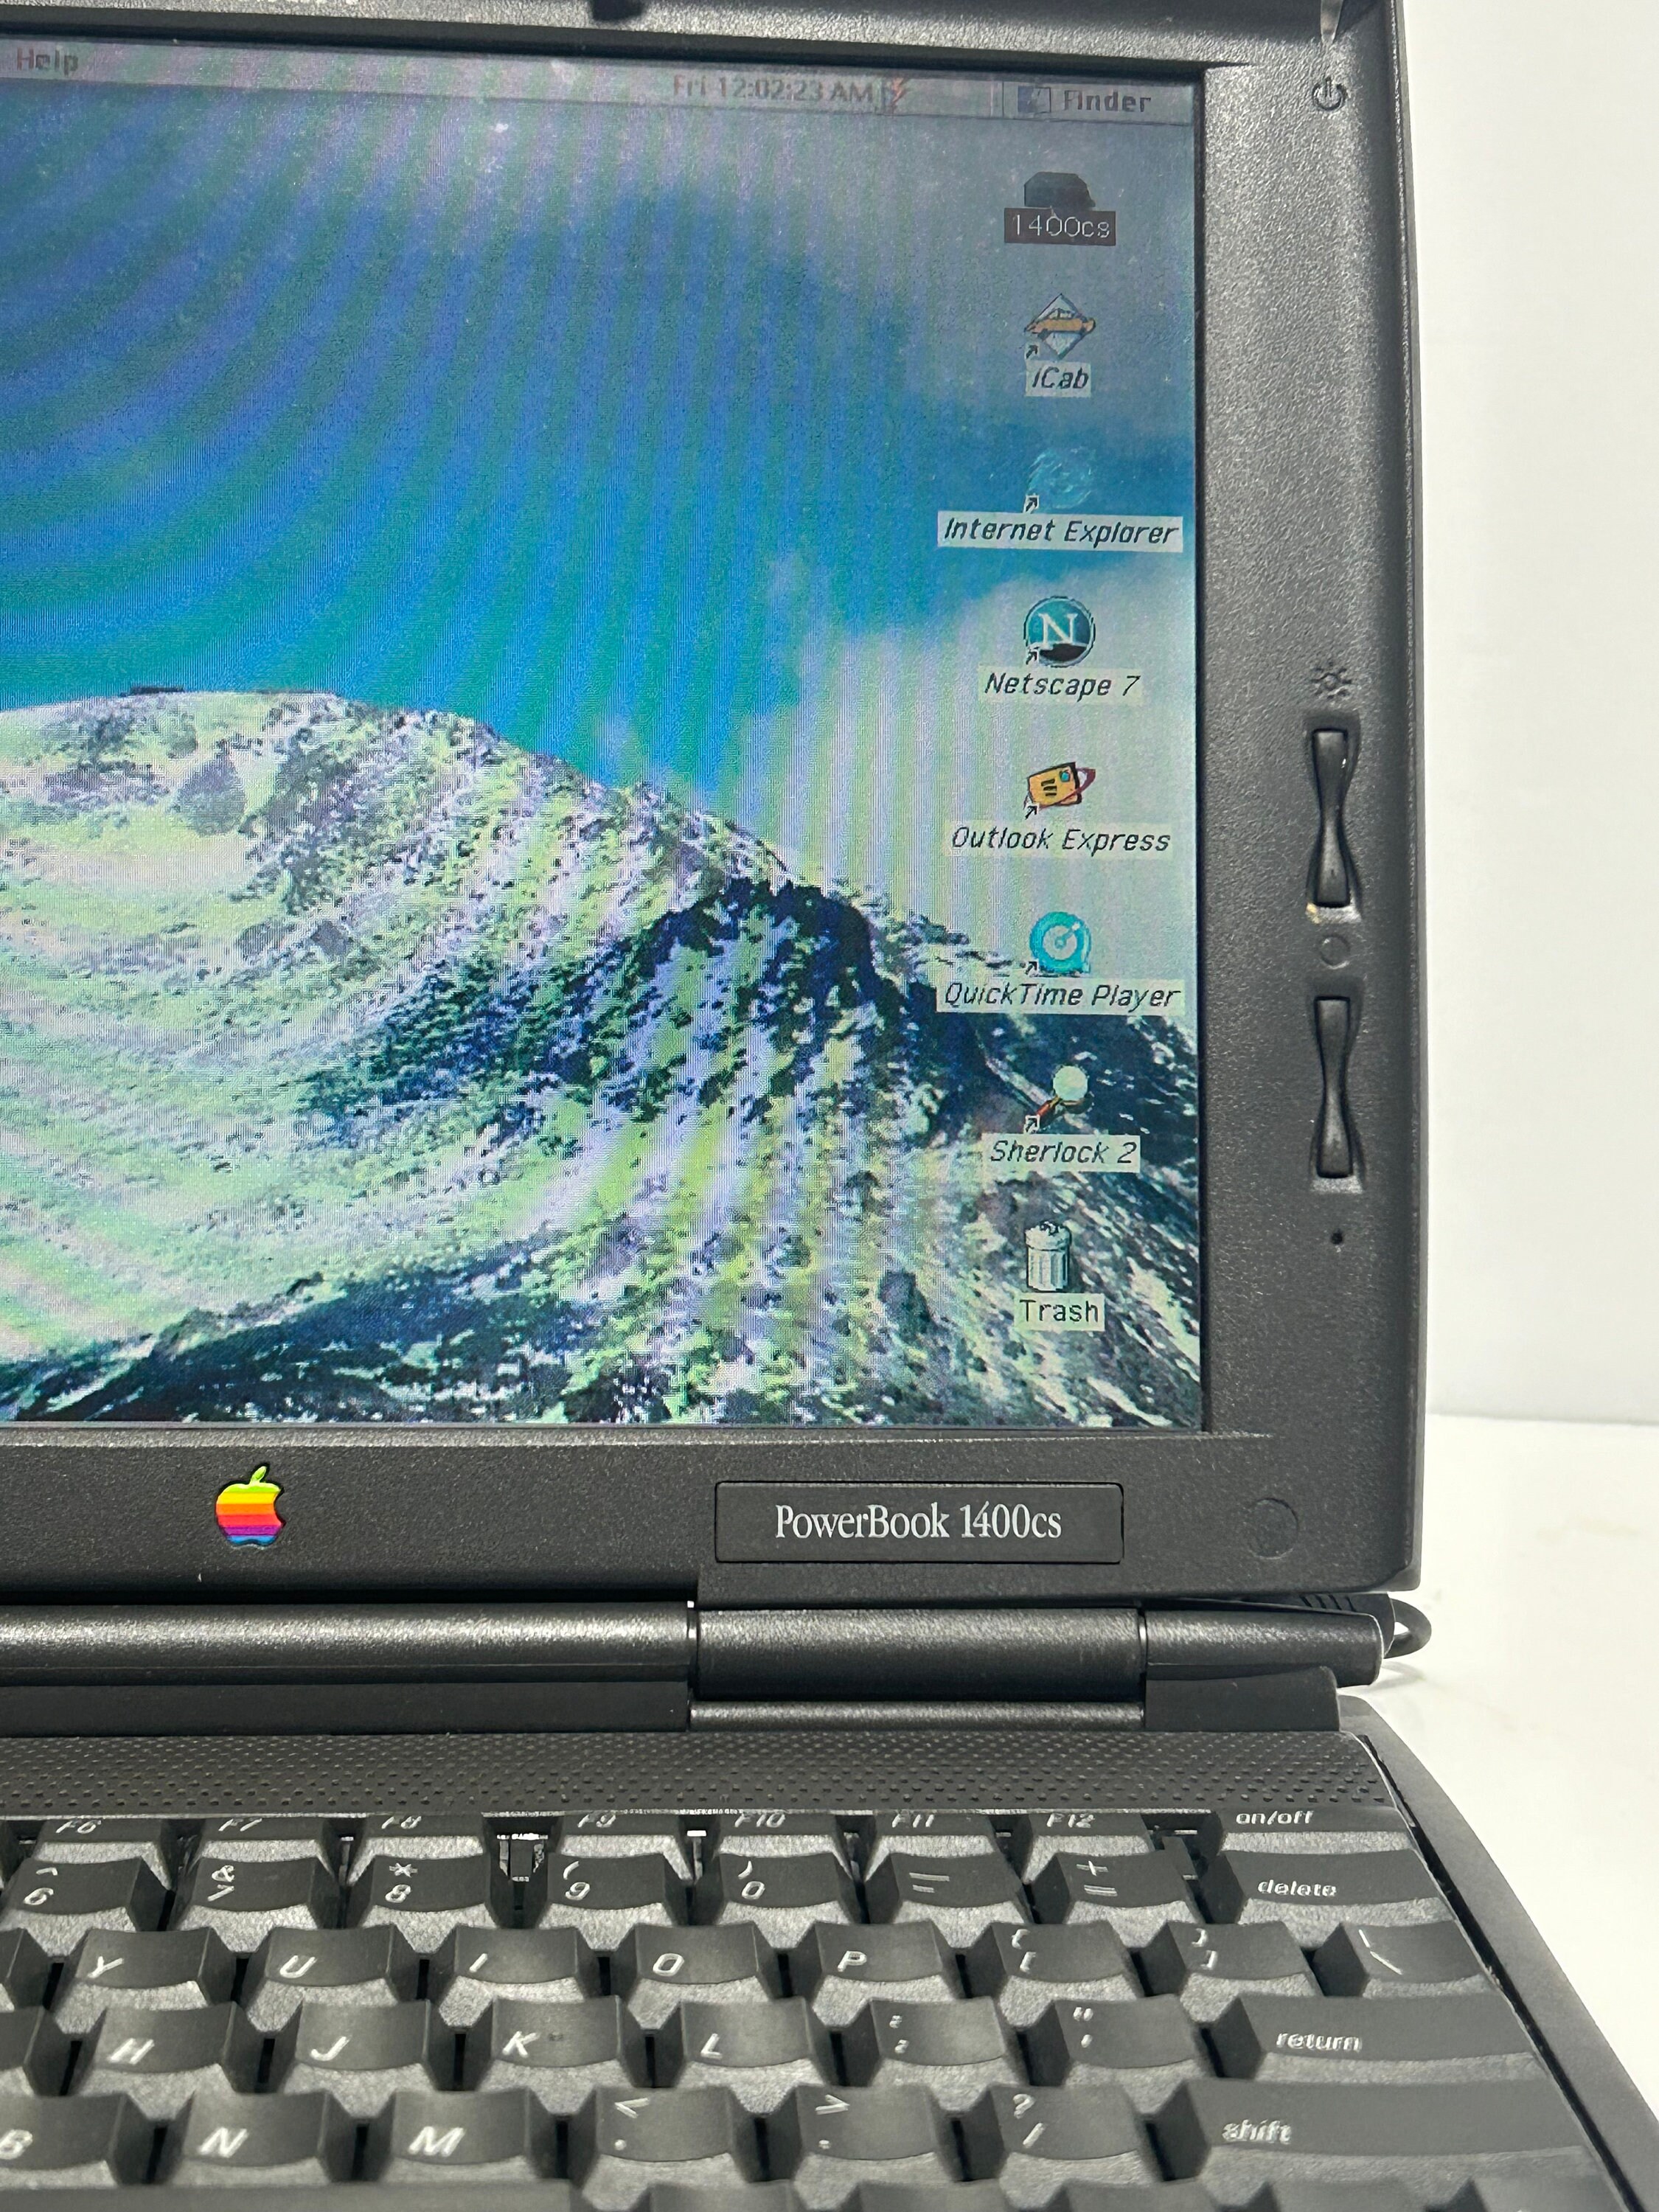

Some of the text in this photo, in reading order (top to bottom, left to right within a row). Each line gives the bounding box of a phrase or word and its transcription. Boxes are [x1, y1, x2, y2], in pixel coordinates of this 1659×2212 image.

[16, 48, 79, 75] Help
[673, 74, 707, 97] Fri
[829, 80, 874, 103] AM
[1063, 89, 1152, 113] Finder
[1012, 214, 1111, 239] 1400cs
[944, 517, 1180, 549] Internet Explorer
[984, 672, 1141, 702] Netscape 7
[951, 827, 1172, 857] Outlook Express
[945, 981, 1182, 1012] QuickTime Player
[990, 1139, 1138, 1164] Sherlock 2
[1019, 1298, 1099, 1323] Trash
[775, 1500, 1062, 1539] PowerBook 1400cs
[1235, 1809, 1315, 1826] on/off
[24, 1888, 55, 1906] 6
[385, 1885, 411, 1902] 8
[564, 1882, 591, 1900] 9
[1257, 1879, 1337, 1897] delete
[88, 1956, 124, 1978] Y
[279, 1955, 317, 1978] U
[838, 1951, 867, 1972] P
[108, 2038, 154, 2065] H
[310, 2037, 350, 2061] J
[503, 2031, 540, 2057] K
[701, 2034, 723, 2059] L
[1276, 2031, 1363, 2052] return
[1012, 2093, 1034, 2118] ?
[199, 2128, 248, 2157] N
[408, 2126, 465, 2157] M
[1222, 2119, 1292, 2145] shift
